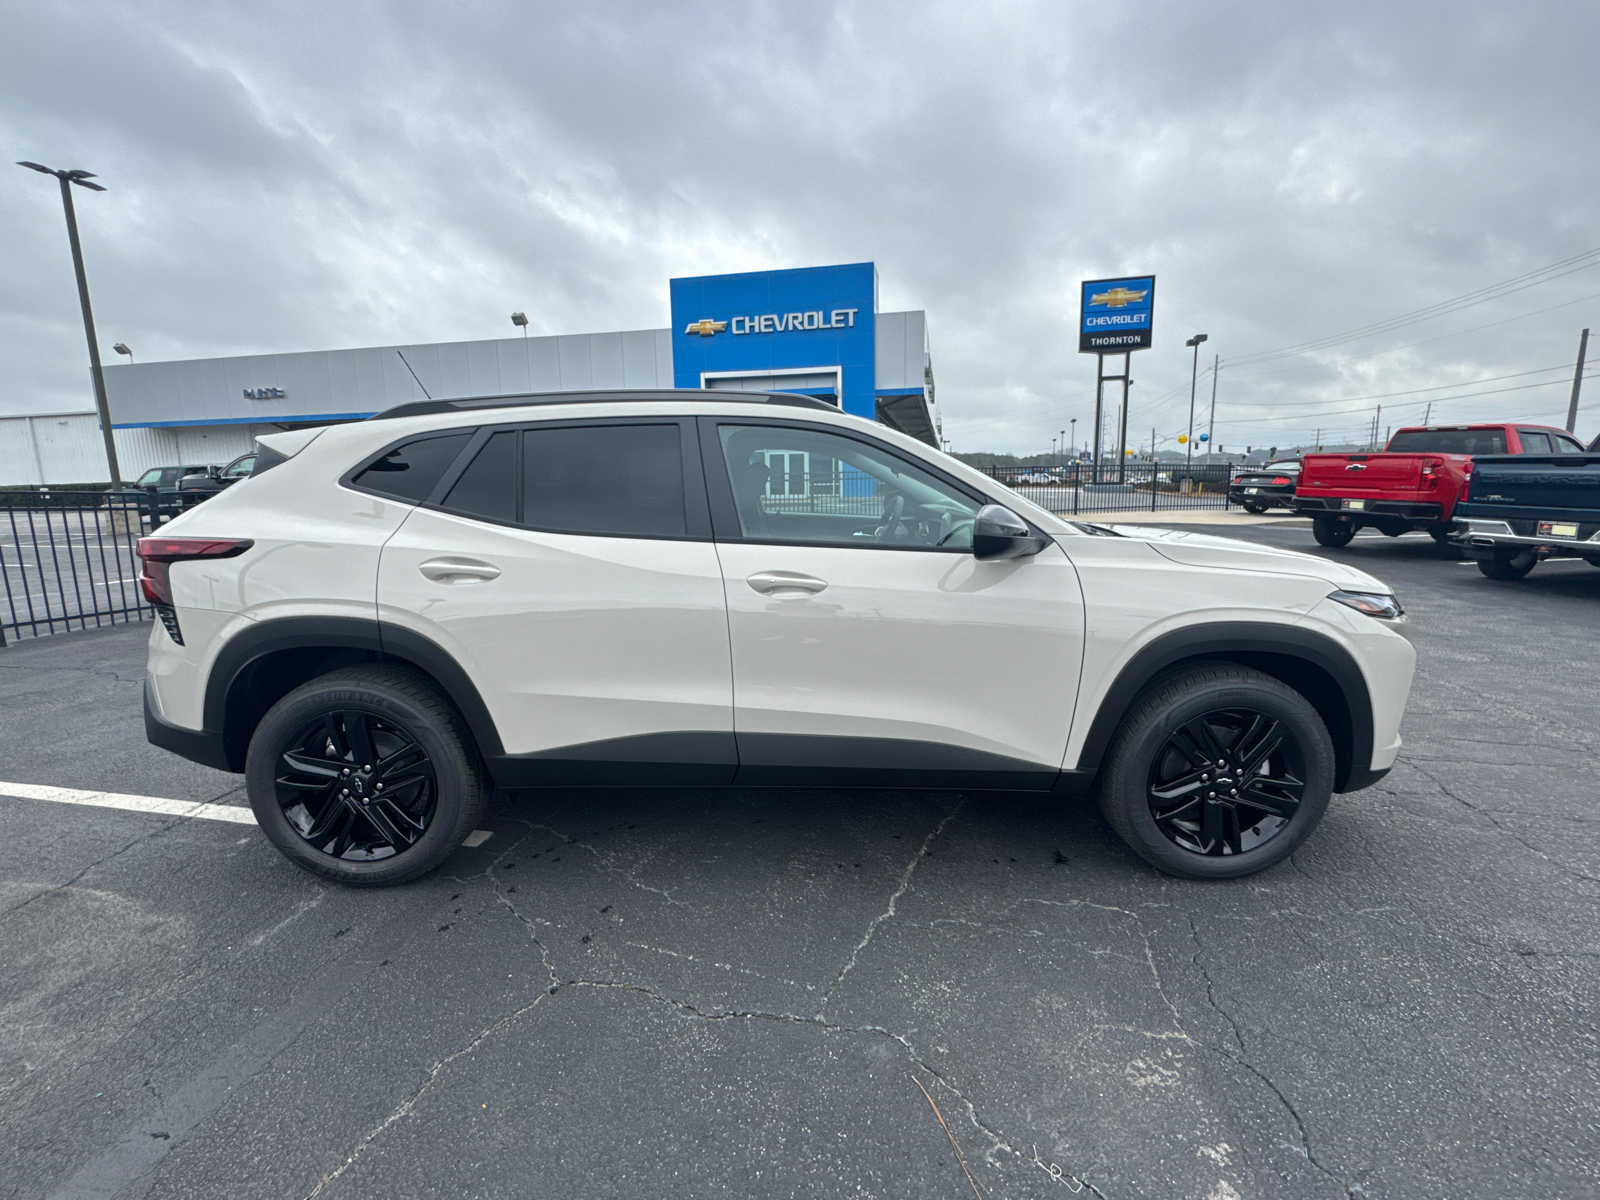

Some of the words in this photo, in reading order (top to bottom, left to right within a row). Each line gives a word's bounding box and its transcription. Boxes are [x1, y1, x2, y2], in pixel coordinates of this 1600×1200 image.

[731, 308, 858, 335] CHEVROLET
[1086, 313, 1147, 326] CHEVROLET
[1090, 335, 1141, 346] THORNTON
[306, 690, 391, 709] ASSURANCE
